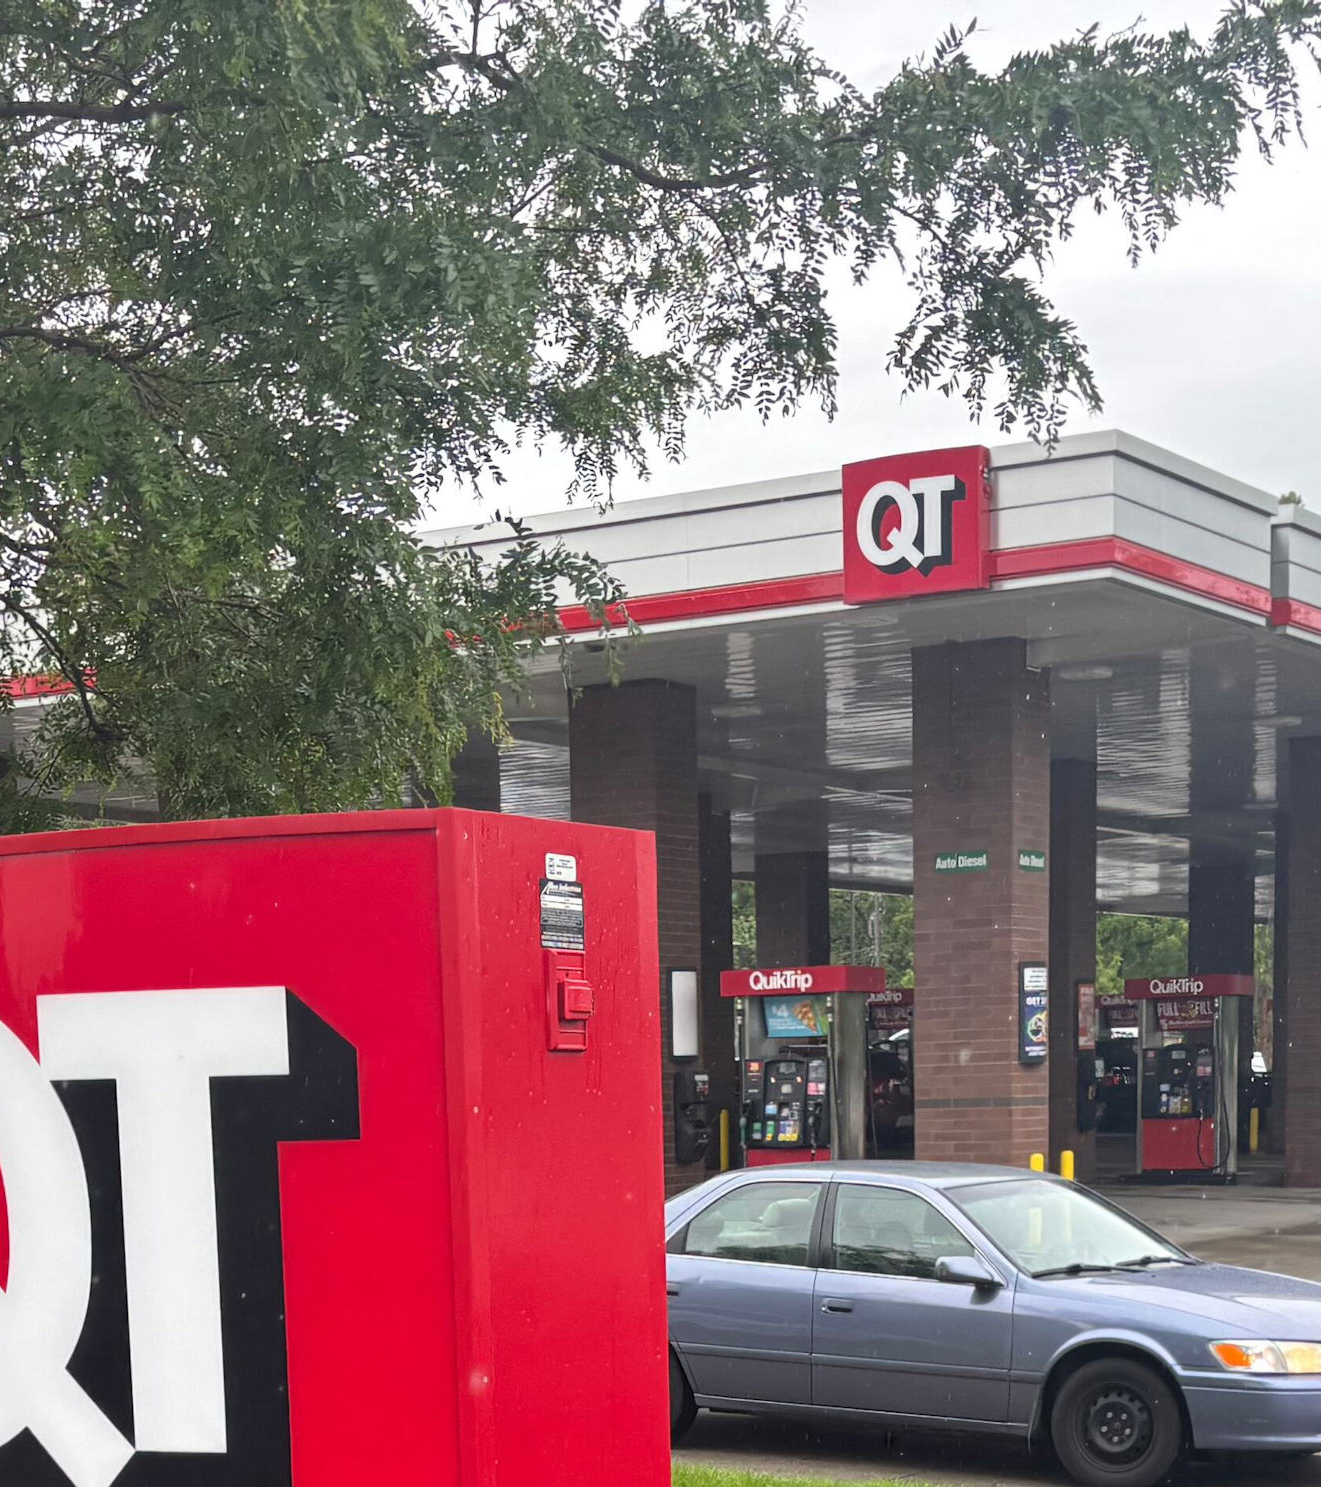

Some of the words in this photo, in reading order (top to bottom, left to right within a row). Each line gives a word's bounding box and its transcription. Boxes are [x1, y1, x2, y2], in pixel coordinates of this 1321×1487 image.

[857, 474, 956, 568] QT
[935, 857, 957, 869] Auto
[958, 854, 987, 867] Diesel
[749, 970, 813, 992] QuikTrip
[1150, 978, 1203, 995] QuikTrip
